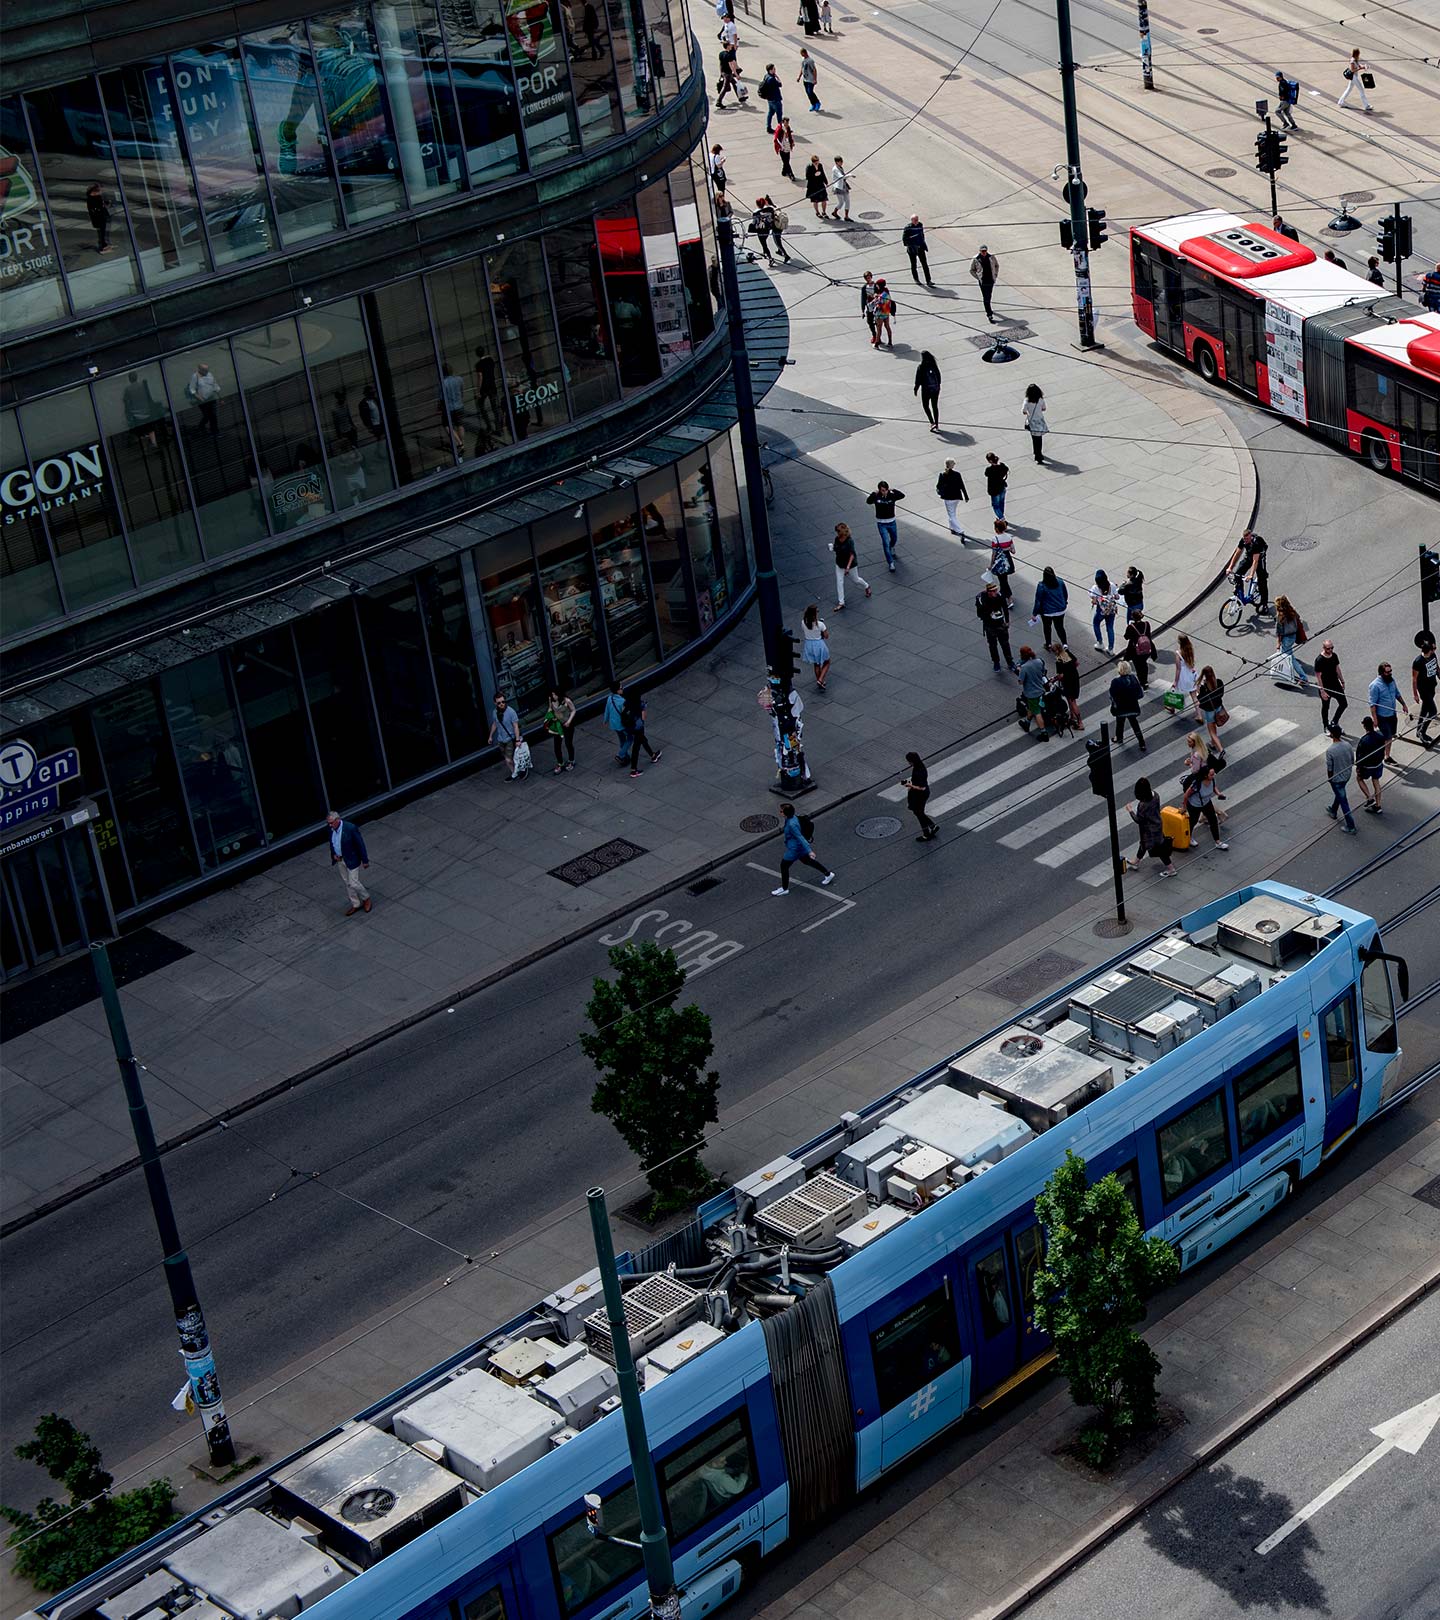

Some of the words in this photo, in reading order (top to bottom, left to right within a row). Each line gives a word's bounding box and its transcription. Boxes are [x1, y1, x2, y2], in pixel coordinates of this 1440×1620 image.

[24, 254, 54, 271] STORE
[514, 380, 559, 409] EGON
[0, 444, 103, 507] GON
[0, 483, 103, 527] STAURANT
[272, 478, 321, 509] EGON
